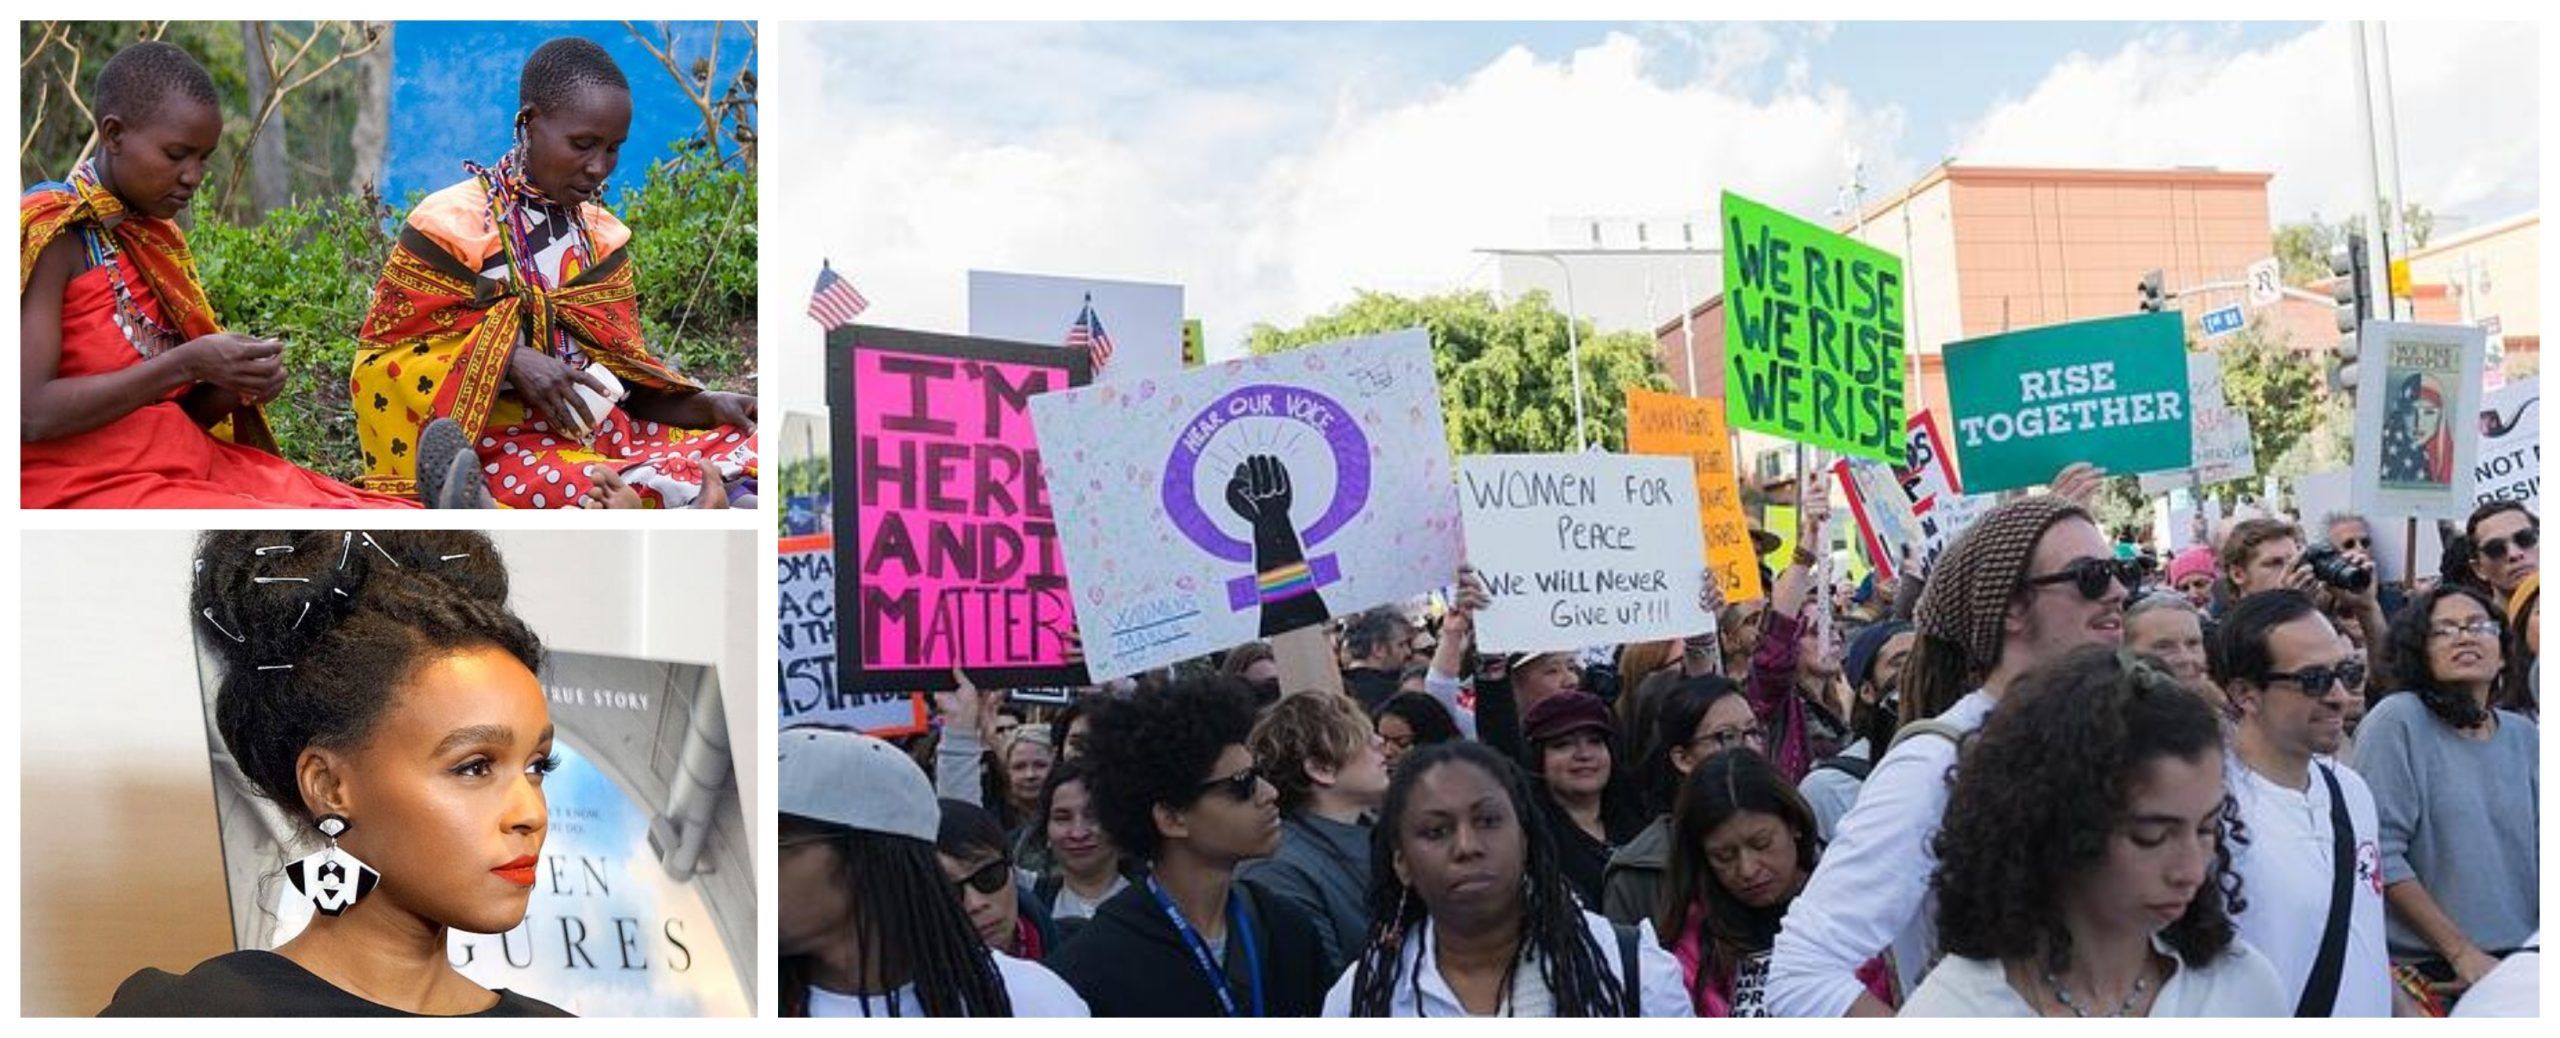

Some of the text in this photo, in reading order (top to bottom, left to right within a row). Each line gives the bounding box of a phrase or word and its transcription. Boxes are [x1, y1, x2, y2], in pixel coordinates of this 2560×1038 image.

[1731, 216, 1900, 334] WE RISE
[1732, 288, 1903, 393] WE RISE
[879, 354, 1048, 438] I'M
[1734, 354, 1805, 433] WE
[1811, 368, 1906, 459] RISE
[2019, 361, 2117, 402] RISE
[1182, 393, 1335, 455] HEAR OUR VOICE
[1960, 391, 2182, 447] TOGETHER
[860, 436, 1053, 518] HERE
[1625, 475, 1674, 506] FOR
[2474, 448, 2524, 482] NOT
[864, 511, 1026, 584] AND
[593, 689, 649, 711] STORY
